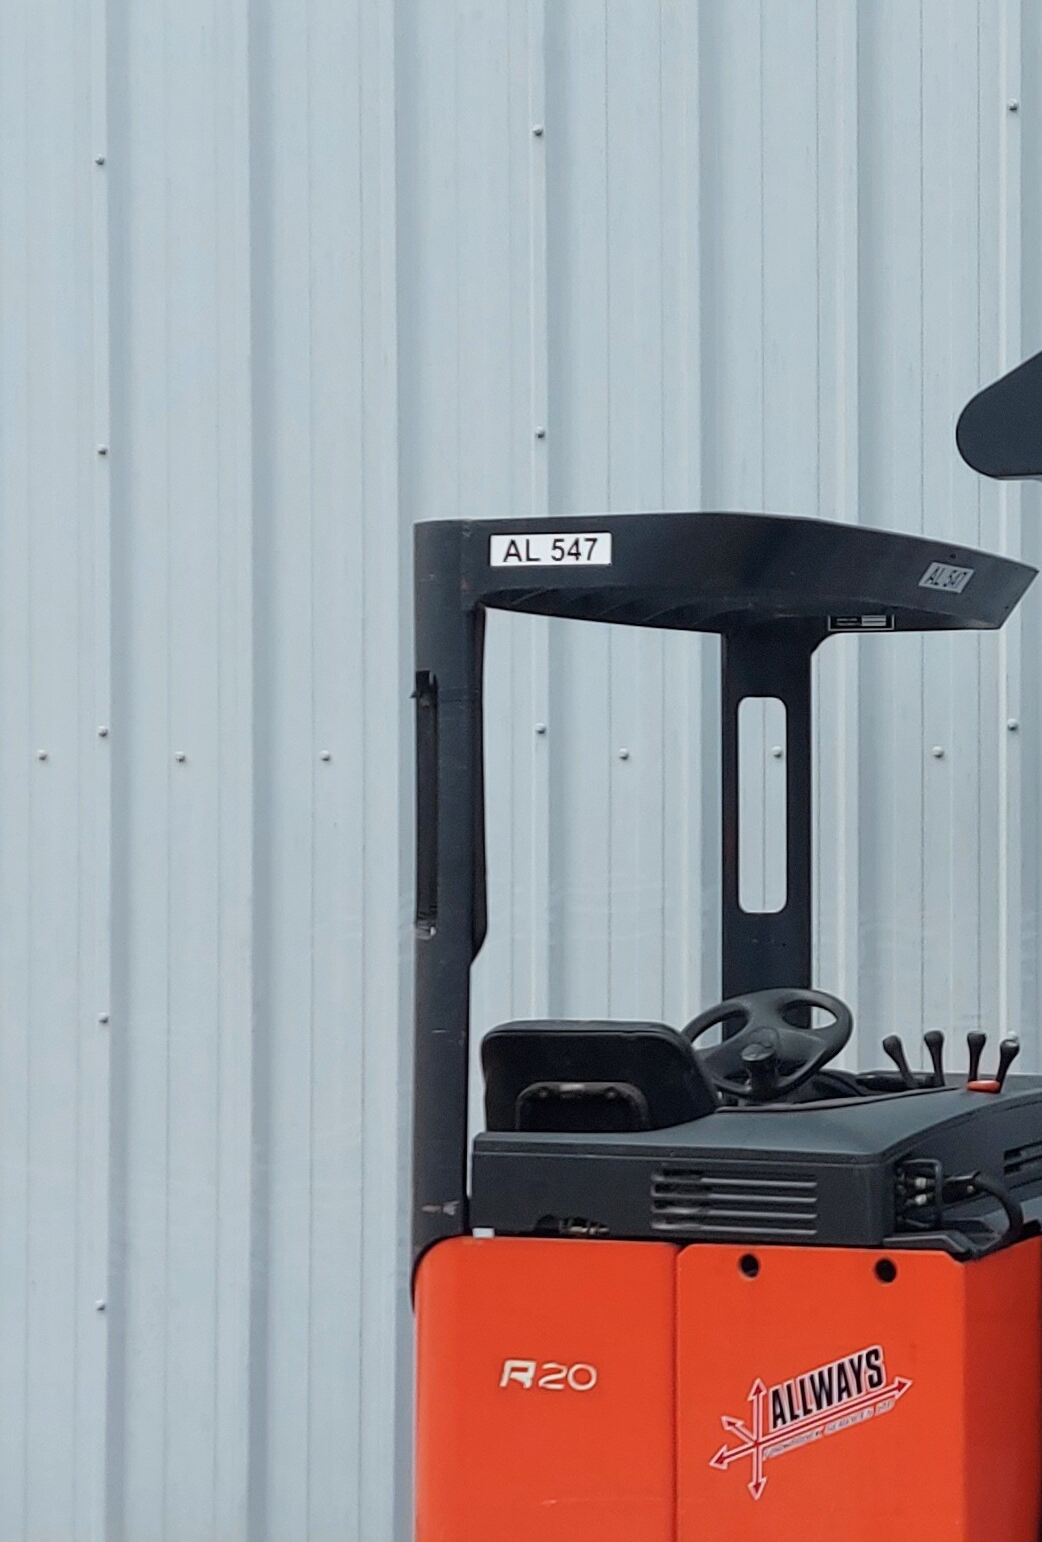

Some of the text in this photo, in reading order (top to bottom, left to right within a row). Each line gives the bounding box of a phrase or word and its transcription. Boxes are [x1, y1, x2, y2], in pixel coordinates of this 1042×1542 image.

[502, 537, 598, 562] AL 547
[771, 1348, 883, 1429] ALLWAYS
